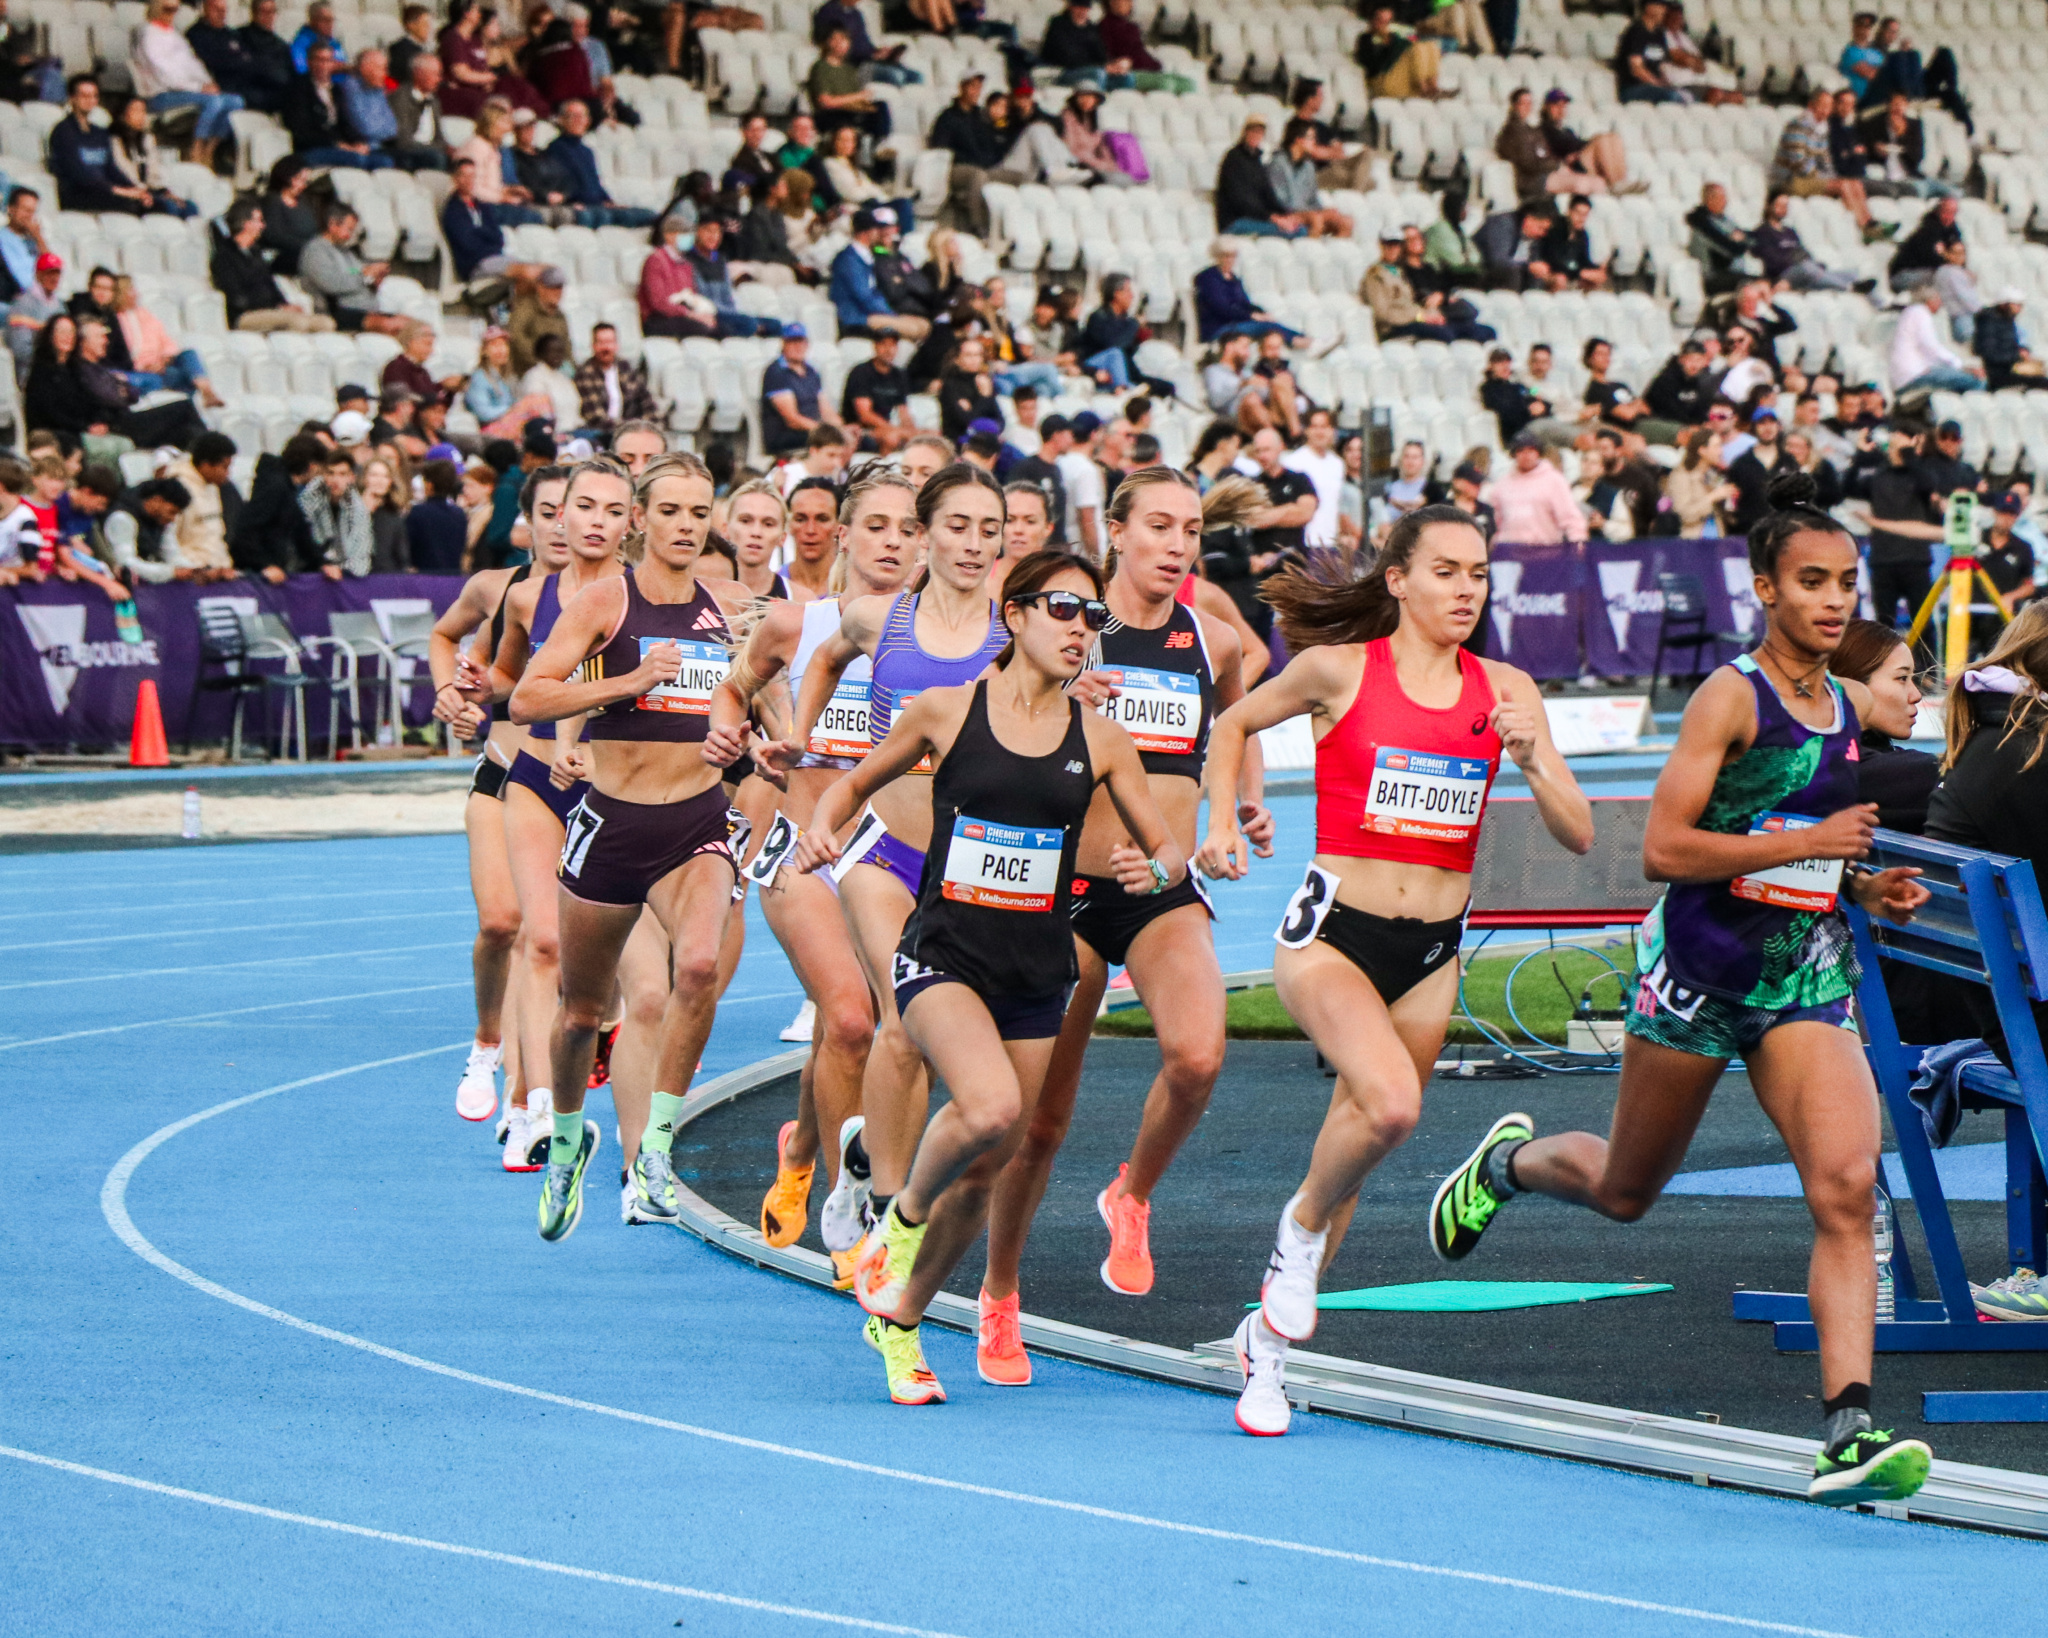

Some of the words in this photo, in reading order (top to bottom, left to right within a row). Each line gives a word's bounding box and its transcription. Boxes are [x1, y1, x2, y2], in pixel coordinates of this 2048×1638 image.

[825, 706, 872, 733] GREG
[1124, 698, 1187, 727] DAVIES
[1132, 737, 1189, 750] elbourne2024
[1410, 756, 1450, 770] CHEMIST
[1375, 780, 1479, 815] BATT-DOYLE
[985, 836, 1024, 847] WAREHOUSE
[987, 827, 1026, 842] CHEMIST
[1401, 823, 1470, 839] Melbourne2024
[752, 816, 791, 879] 9
[981, 853, 1031, 882] PACE
[978, 892, 1047, 907] Melbourne2024
[1281, 870, 1326, 942] 3
